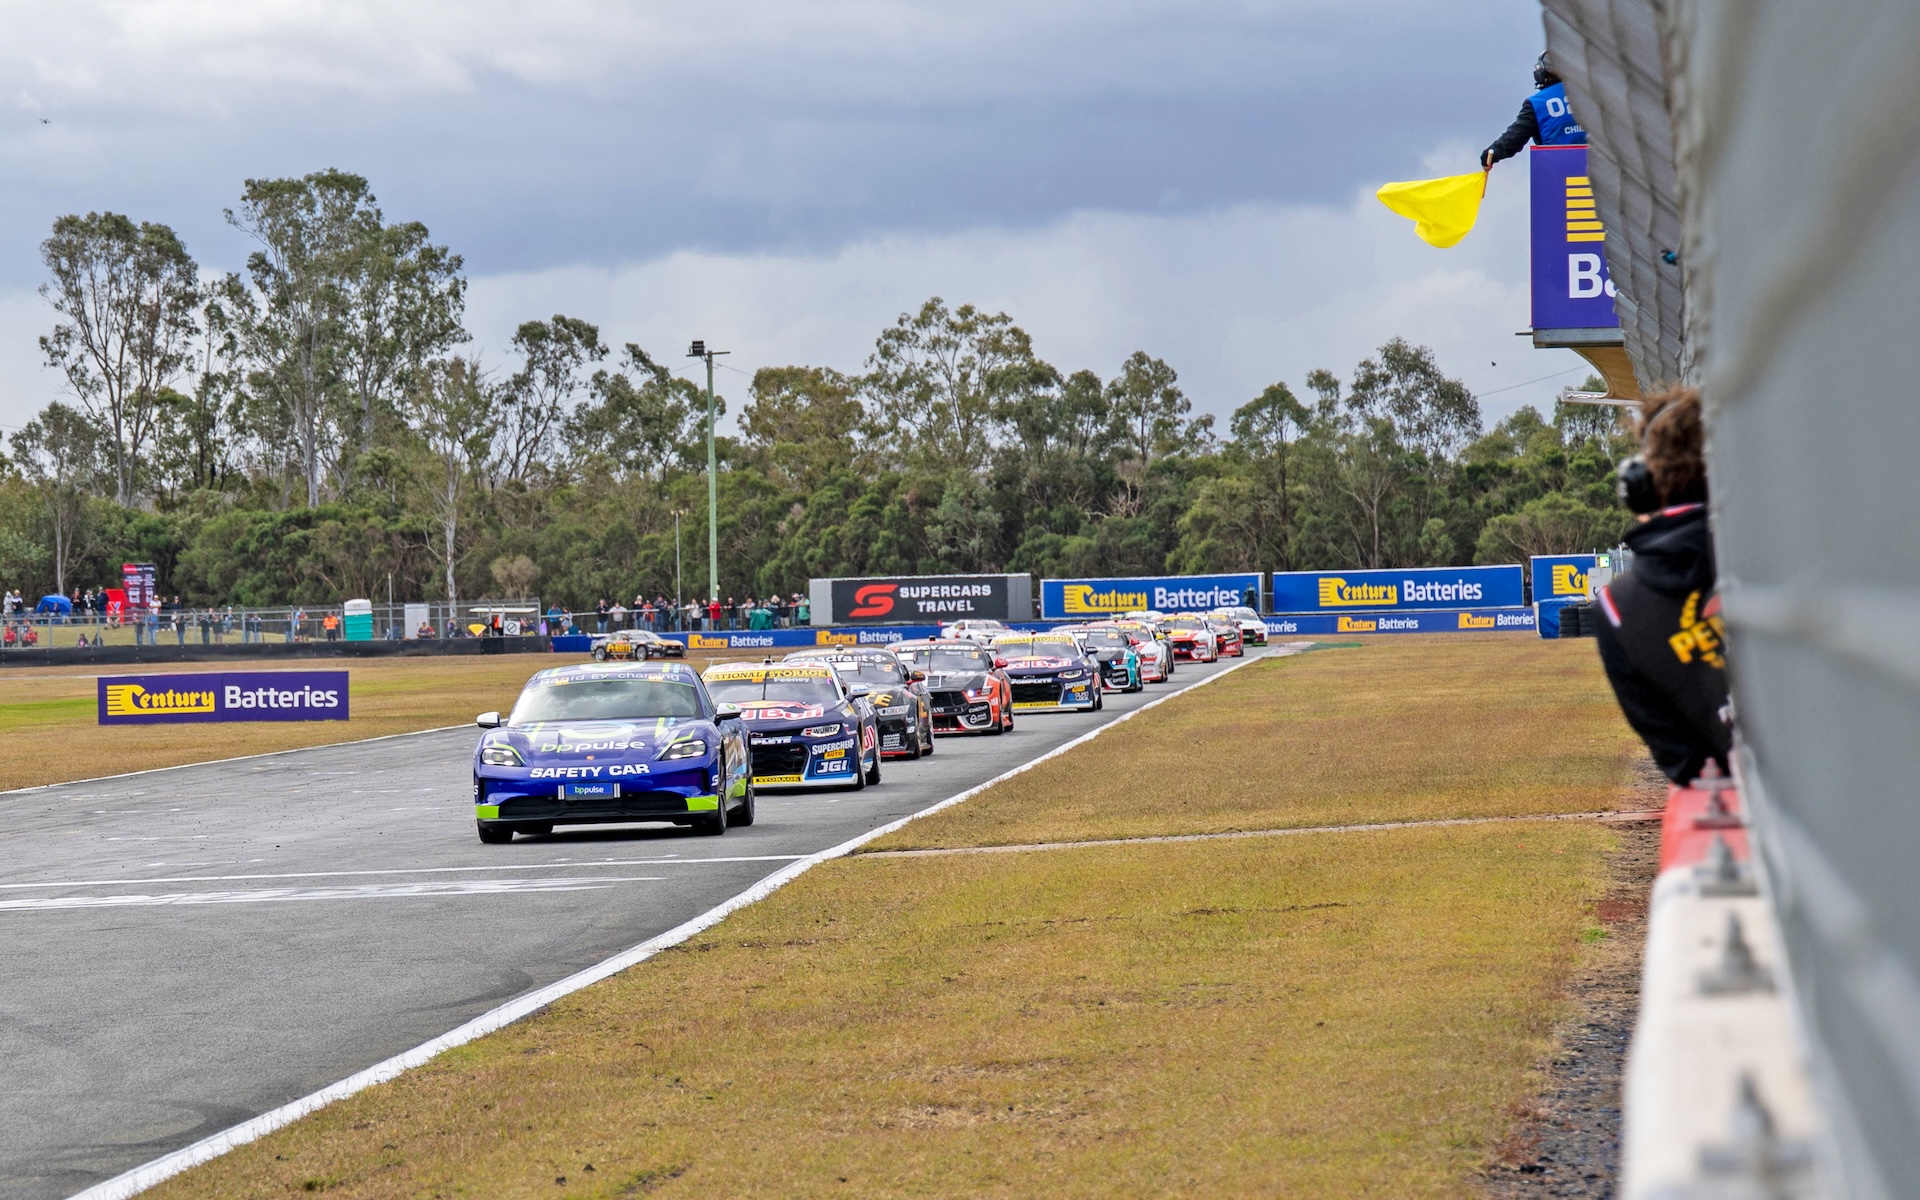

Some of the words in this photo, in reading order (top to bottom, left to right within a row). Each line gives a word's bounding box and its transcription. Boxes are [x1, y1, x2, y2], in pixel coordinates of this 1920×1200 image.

[900, 585, 991, 599] SUPERCARS
[1063, 584, 1148, 614] Century
[1154, 585, 1240, 608] Batteries
[1318, 577, 1398, 607] Century
[1403, 579, 1482, 602] Batteries
[917, 600, 975, 613] TRAVEL
[1338, 616, 1376, 632] Century
[1379, 617, 1419, 630] Batteries
[1458, 613, 1495, 629] Century
[1497, 613, 1534, 626] Batteries
[688, 634, 728, 649] Century
[731, 635, 774, 647] Batteries
[816, 631, 857, 645] Century
[860, 630, 903, 643] Batteries
[591, 673, 610, 681] EV
[706, 671, 763, 681] NATIONAL
[767, 668, 829, 679] STORAGE
[107, 684, 215, 716] Century
[225, 685, 338, 708] Batteries
[759, 705, 824, 720] Bull
[530, 767, 603, 779] SAFETY
[609, 764, 651, 776] CAR
[817, 760, 848, 773] JGI
